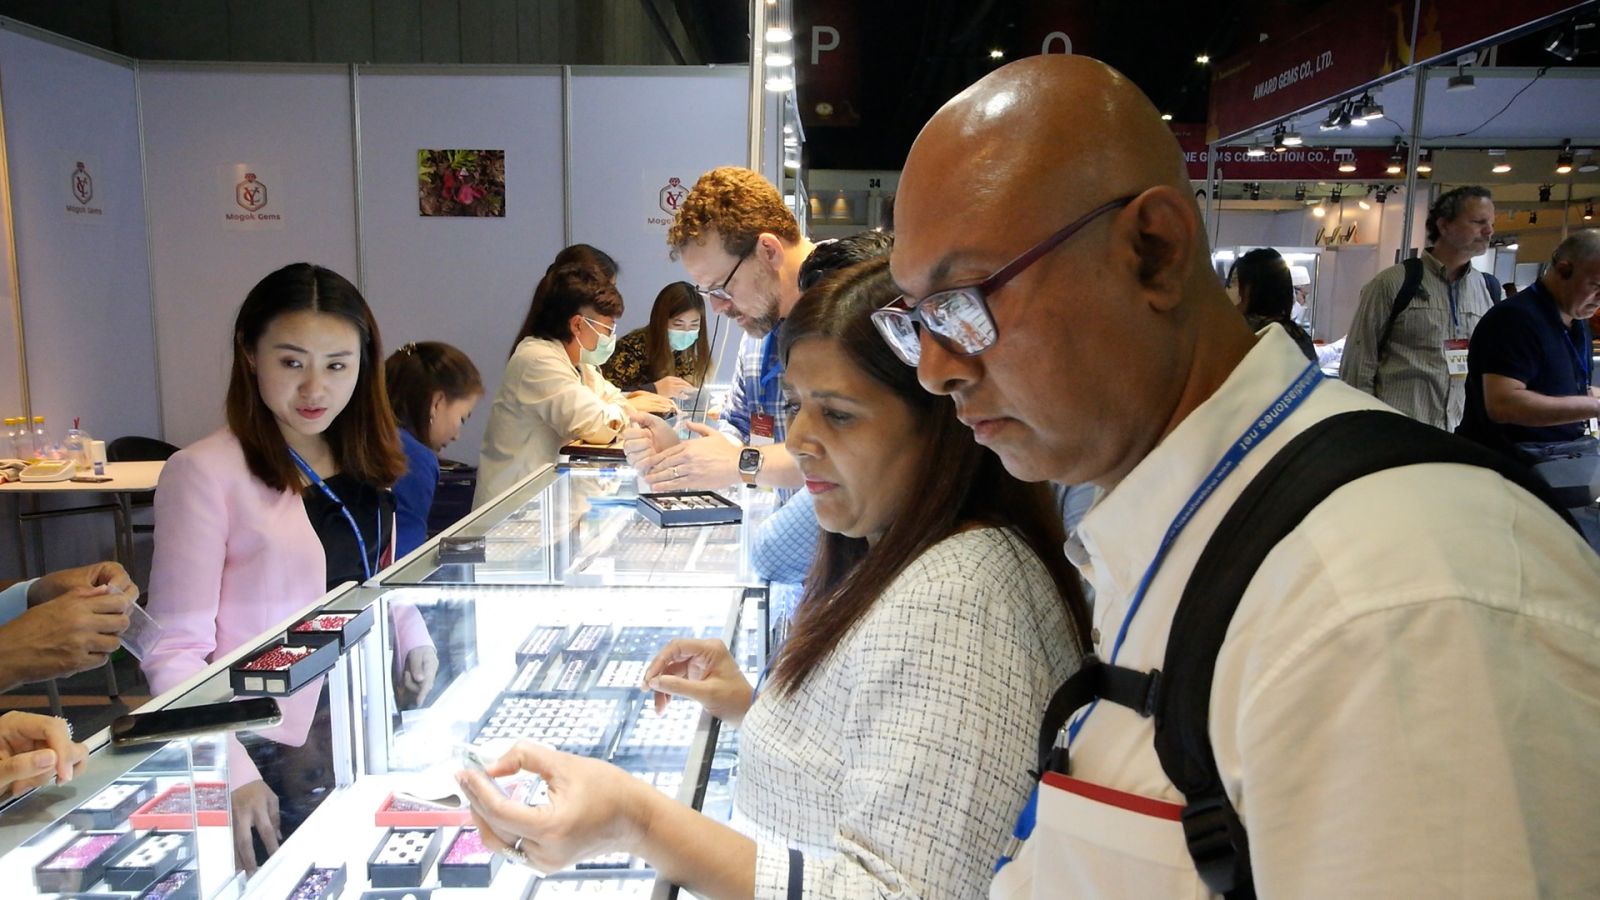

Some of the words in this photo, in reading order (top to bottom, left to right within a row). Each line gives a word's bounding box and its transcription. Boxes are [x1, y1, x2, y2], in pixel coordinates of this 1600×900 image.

[811, 25, 840, 65] P
[1252, 76, 1278, 101] AWARD
[1278, 66, 1300, 90] GEMS
[1315, 50, 1335, 73] LTD.
[1199, 151, 1233, 163] GMS
[1234, 151, 1305, 162] COLLECTION
[1307, 151, 1330, 164] CO.,
[869, 178, 881, 189] 34
[225, 212, 256, 221] Mogok
[257, 213, 281, 221] Gems
